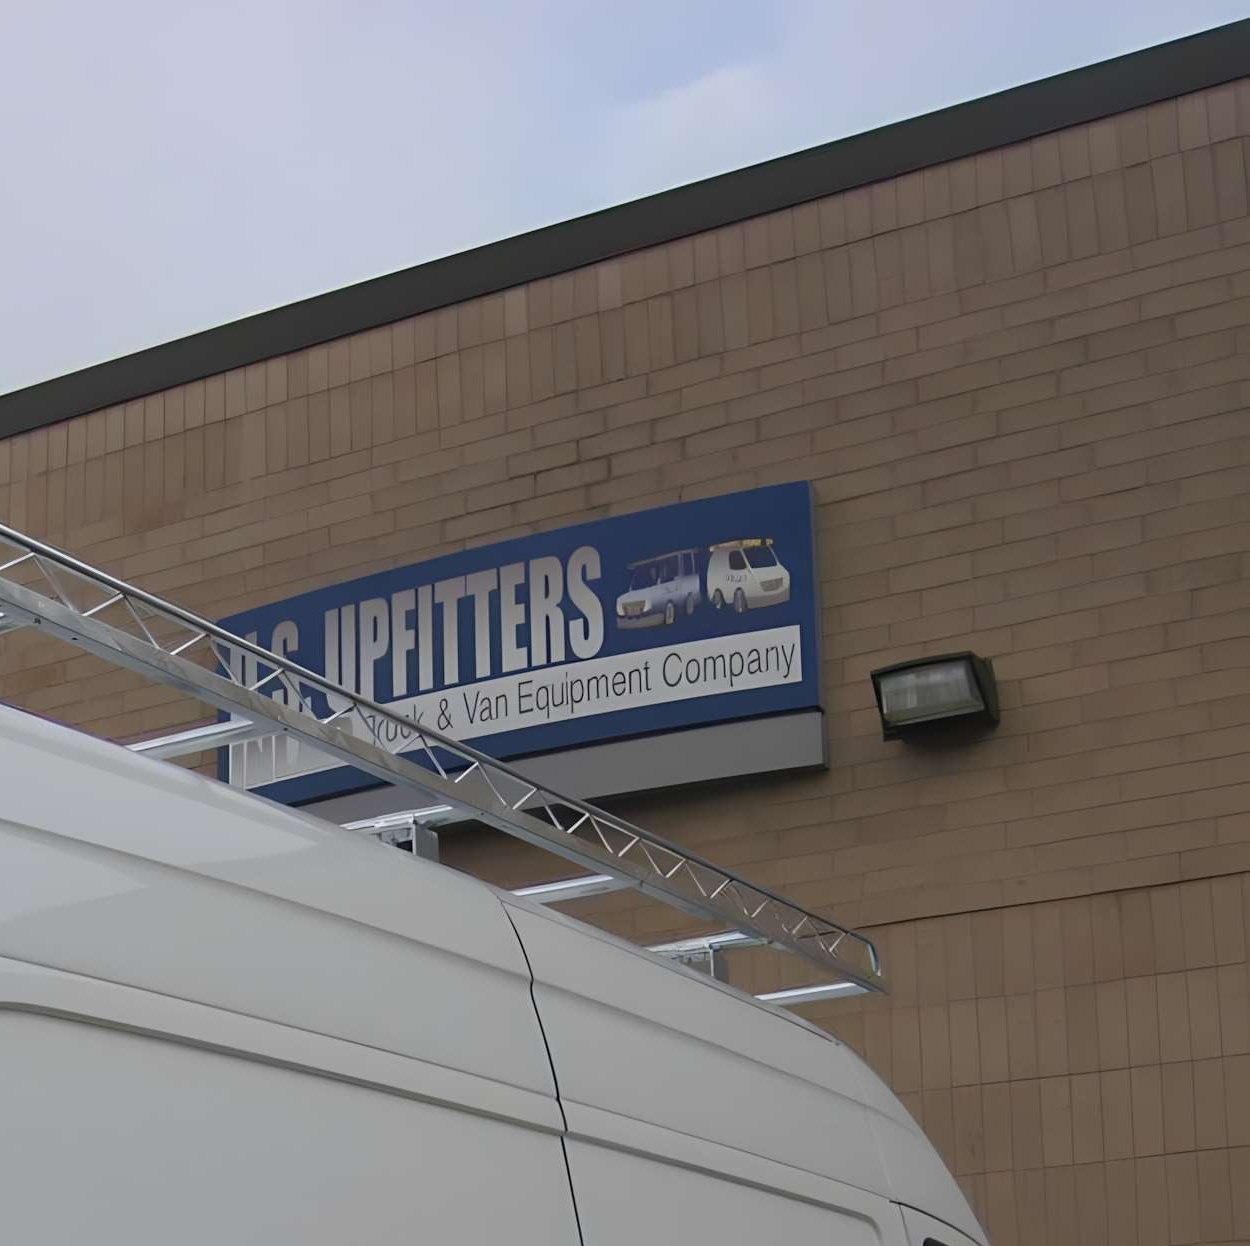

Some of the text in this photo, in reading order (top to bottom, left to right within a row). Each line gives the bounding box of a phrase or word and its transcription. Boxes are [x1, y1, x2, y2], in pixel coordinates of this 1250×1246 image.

[325, 545, 605, 713] UPFITTERS
[437, 698, 454, 731] &
[463, 690, 508, 725] Van
[518, 661, 651, 719] Equipment
[662, 643, 796, 687] Company
